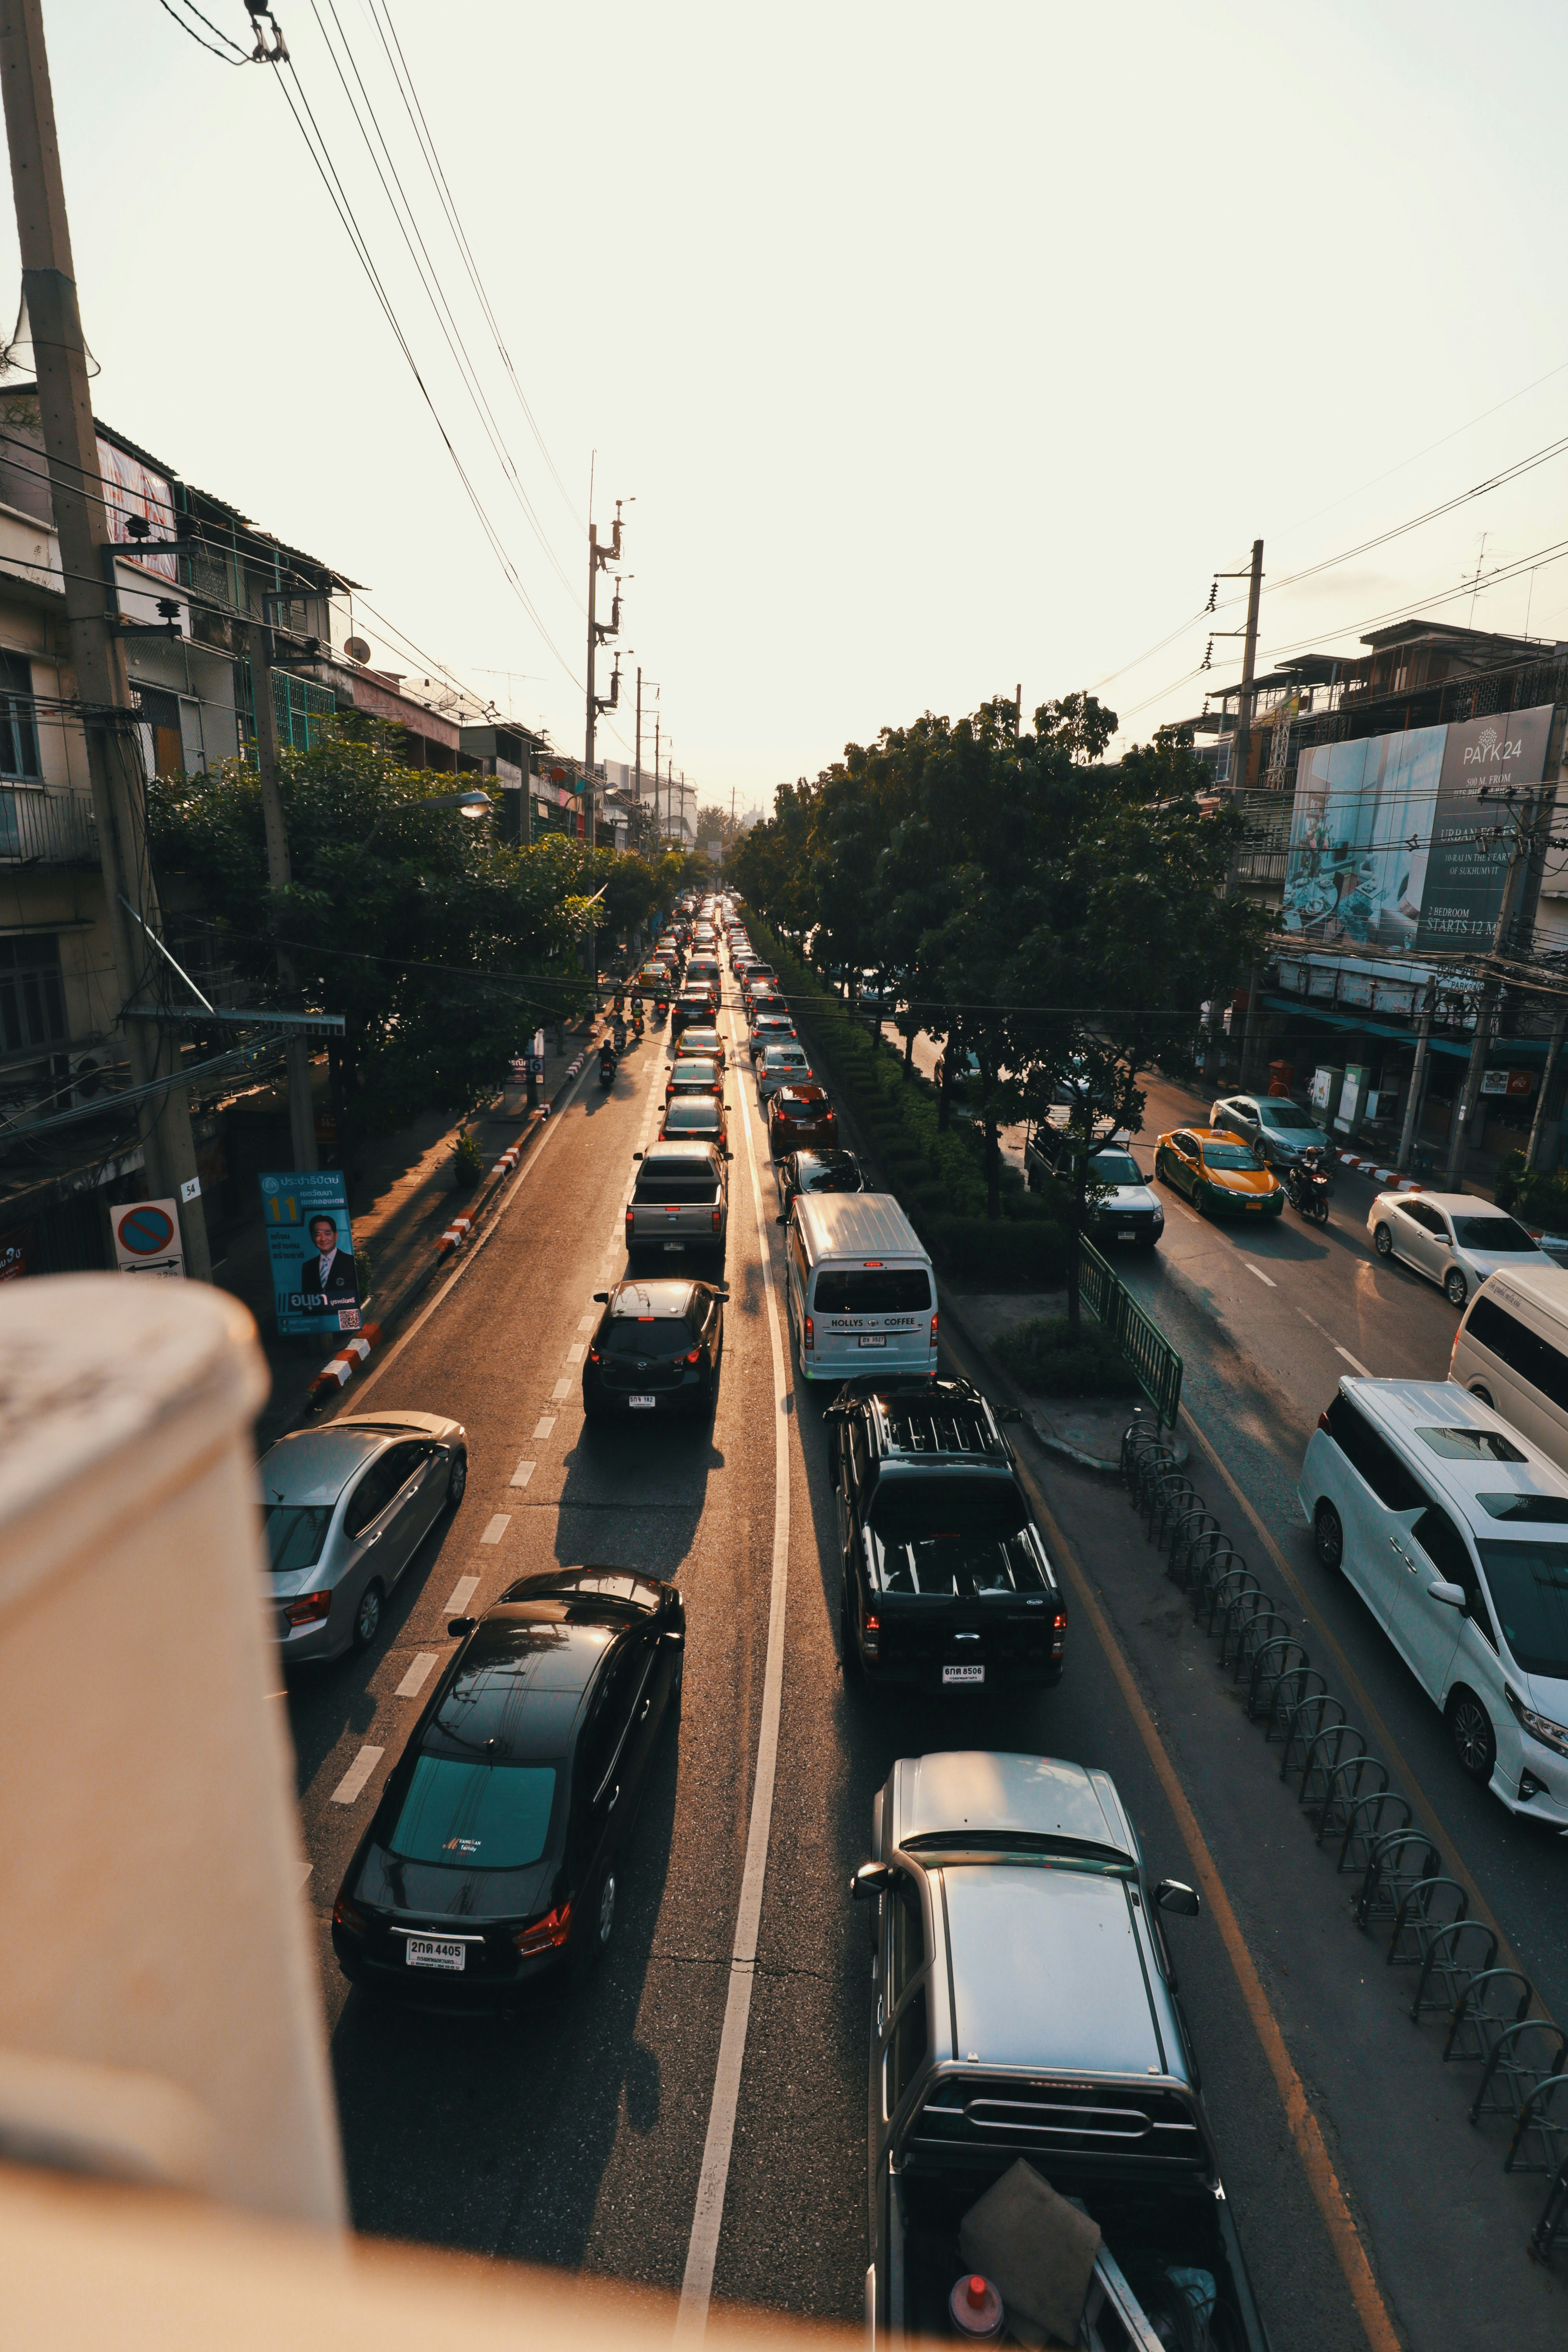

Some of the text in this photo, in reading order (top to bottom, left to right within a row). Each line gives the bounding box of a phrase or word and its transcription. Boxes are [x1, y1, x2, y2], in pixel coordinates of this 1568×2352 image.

[1466, 778, 1477, 787] 500
[1489, 773, 1511, 784] FROM
[1441, 828, 1477, 841] URBAN
[1459, 867, 1499, 875] SUKHUMVIT
[1434, 907, 1469, 918] BEDROOM
[1427, 917, 1468, 933] STARTS
[1472, 921, 1483, 934] 12
[532, 1060, 541, 1071] 6
[187, 1184, 195, 1196] 54
[269, 1196, 297, 1221] 11
[291, 1294, 328, 1310] อนุชา
[436, 1944, 461, 1956] 4405
